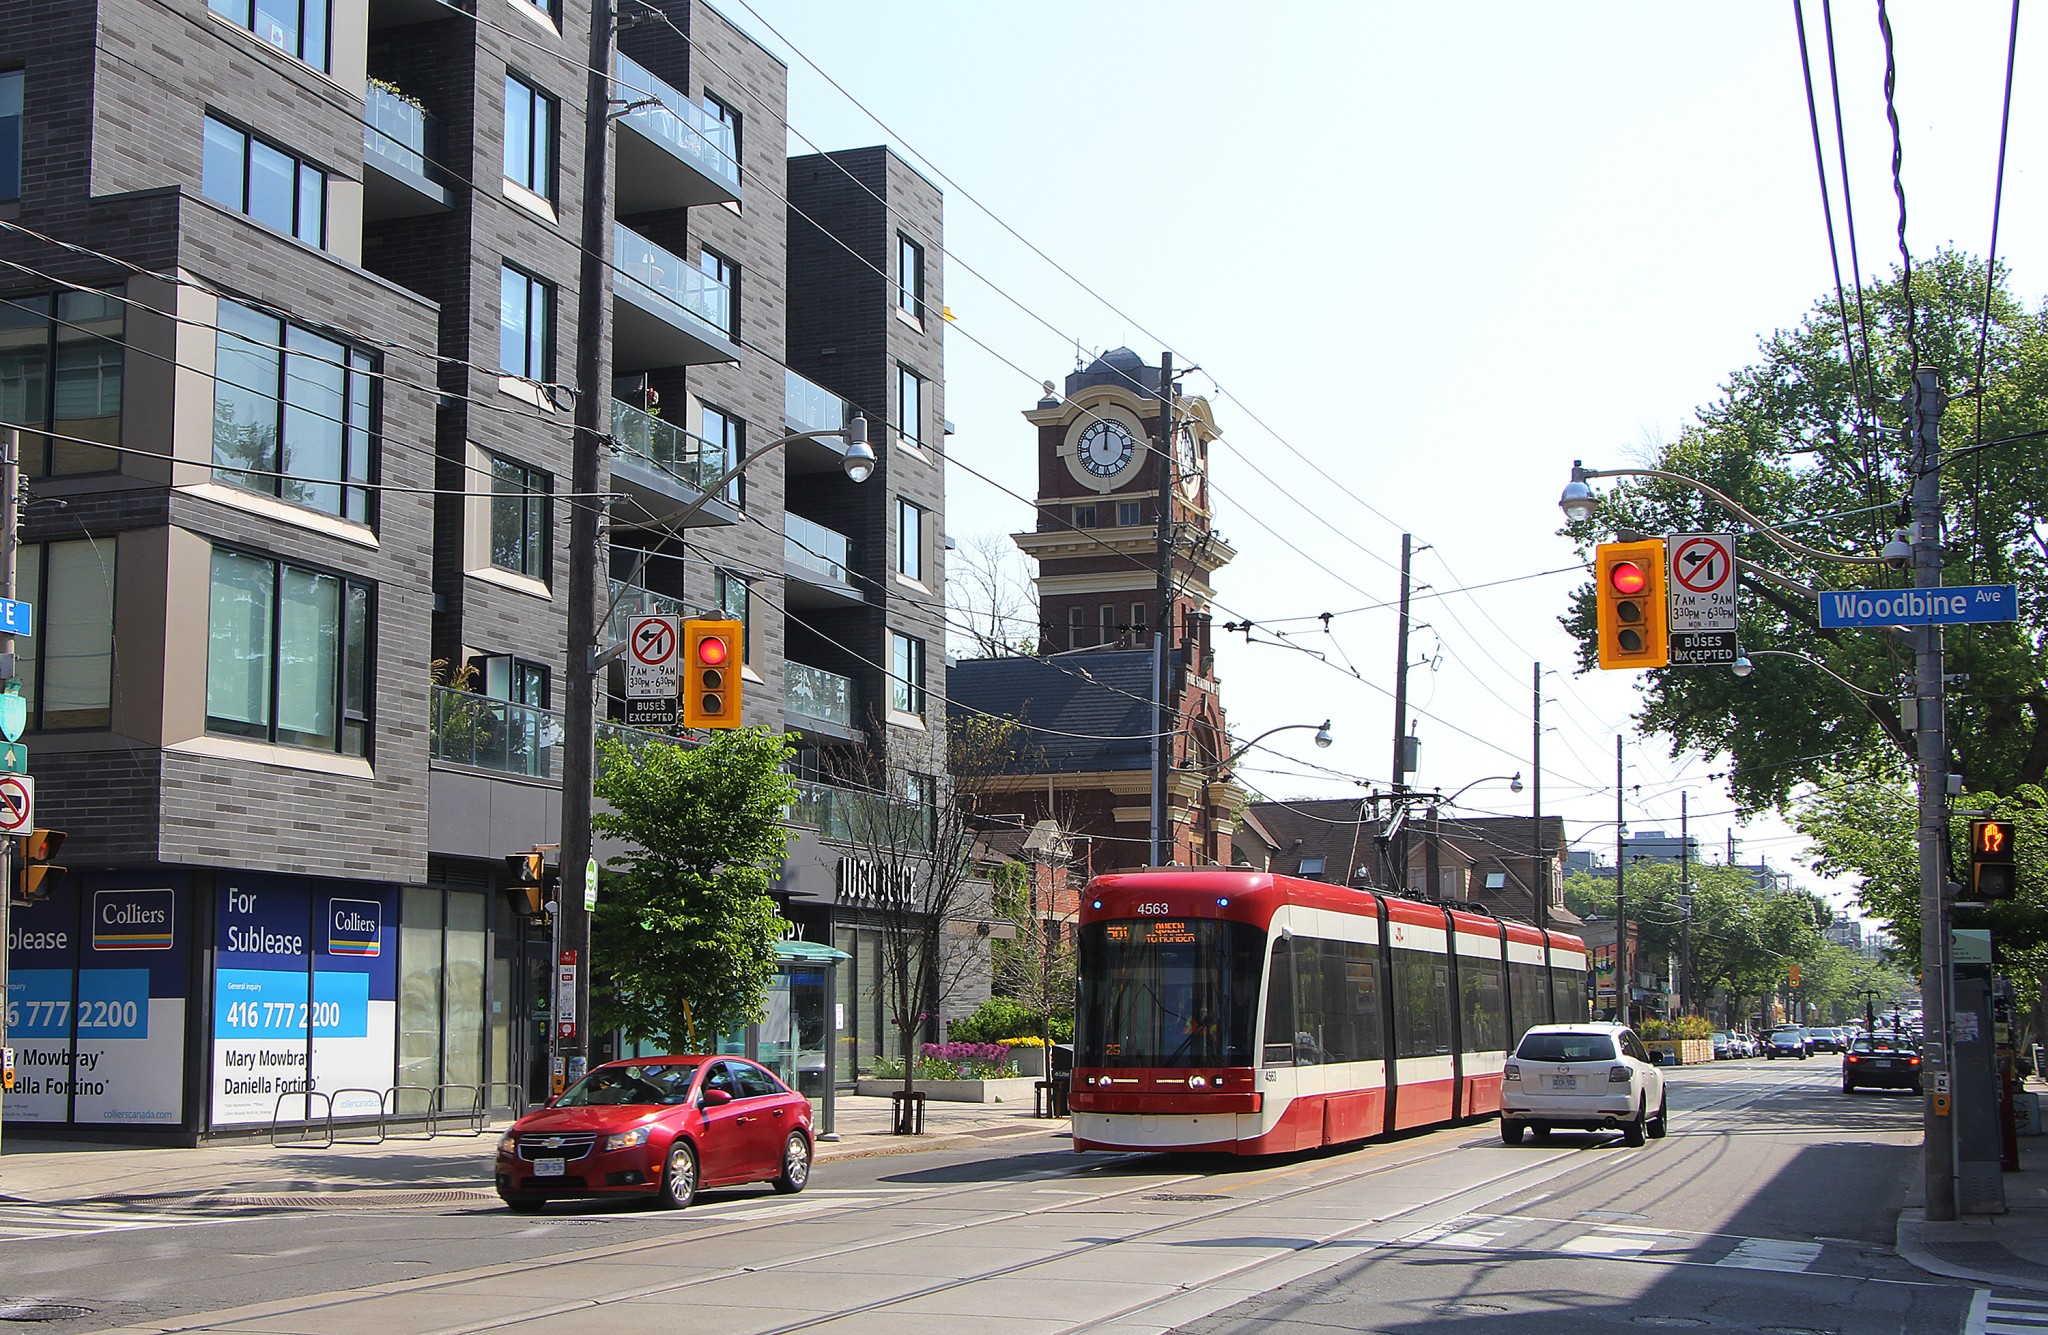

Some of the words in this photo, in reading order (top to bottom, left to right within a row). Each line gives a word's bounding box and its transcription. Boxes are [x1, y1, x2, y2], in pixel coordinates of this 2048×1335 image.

[1711, 593, 1733, 605] 9AM
[1834, 592, 1967, 619] Woodbine
[1975, 590, 2001, 602] Ave
[1684, 636, 1722, 648] BUSES
[1674, 649, 1733, 661] EXCEPTED
[637, 702, 666, 711] BUSES
[629, 713, 674, 722] EXCEPTED
[841, 857, 877, 901] JUGO
[228, 887, 257, 914] For
[102, 903, 165, 925] Colliers
[1137, 903, 1169, 915] 4563
[335, 911, 376, 932] Colliers
[1155, 922, 1185, 934] QUEEN
[228, 926, 303, 955] Sublease
[1107, 926, 1128, 940] 501
[228, 982, 245, 990] General
[246, 983, 262, 992] inquiry
[26, 1001, 70, 1027] 777
[78, 1001, 138, 1028] 2200
[227, 1001, 259, 1028] 416
[263, 1002, 295, 1029] 777
[299, 1001, 340, 1028] 2200
[225, 1050, 256, 1071] Mary
[224, 1077, 272, 1095] Daniella
[103, 1110, 172, 1119] collierscanada.com
